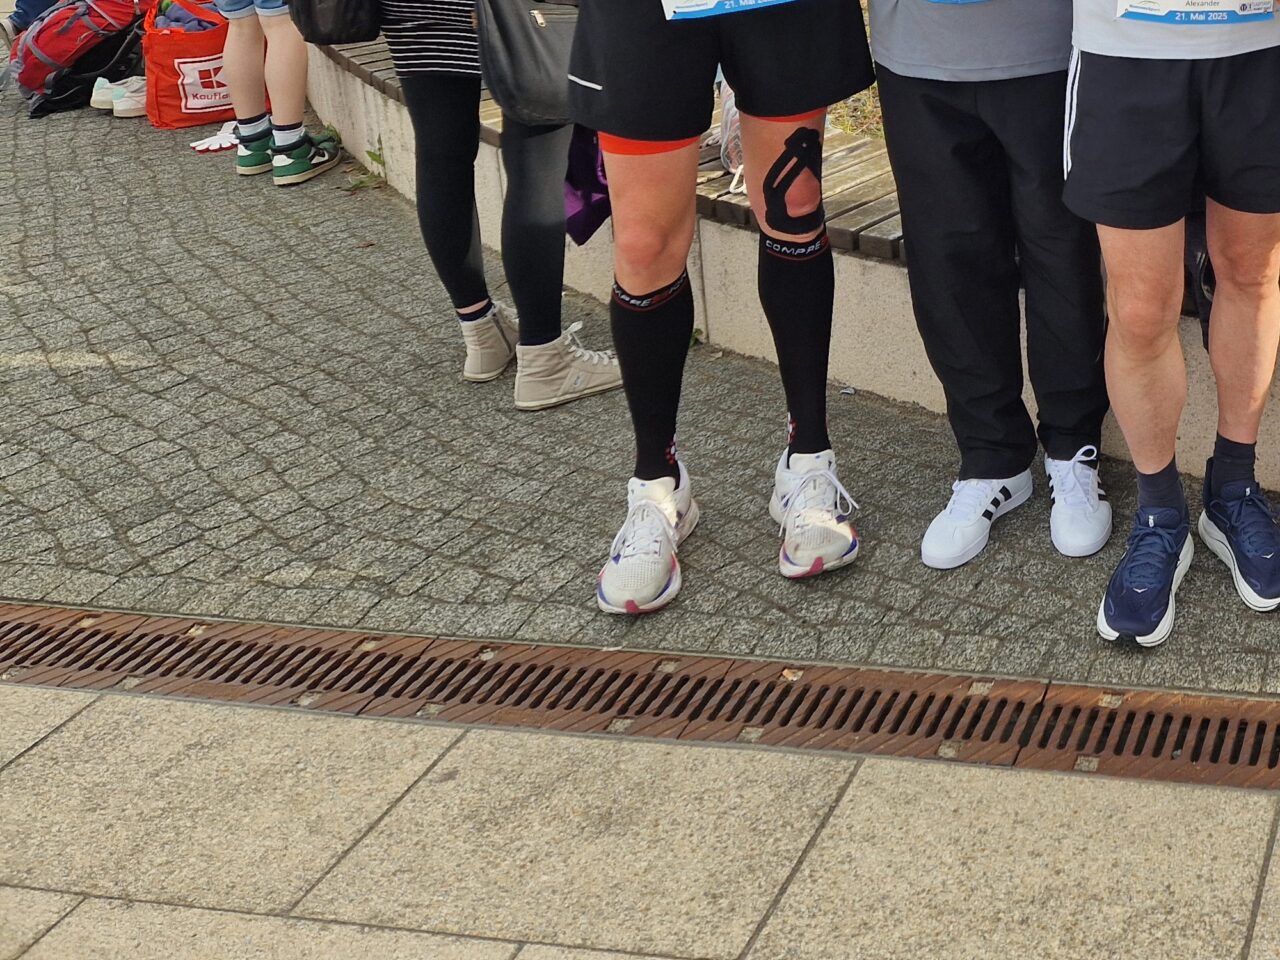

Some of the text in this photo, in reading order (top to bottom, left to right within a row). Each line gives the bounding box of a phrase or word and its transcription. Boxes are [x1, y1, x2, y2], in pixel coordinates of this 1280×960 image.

[724, 0, 738, 9] 21.
[1175, 12, 1228, 21] 21. Mai 2025
